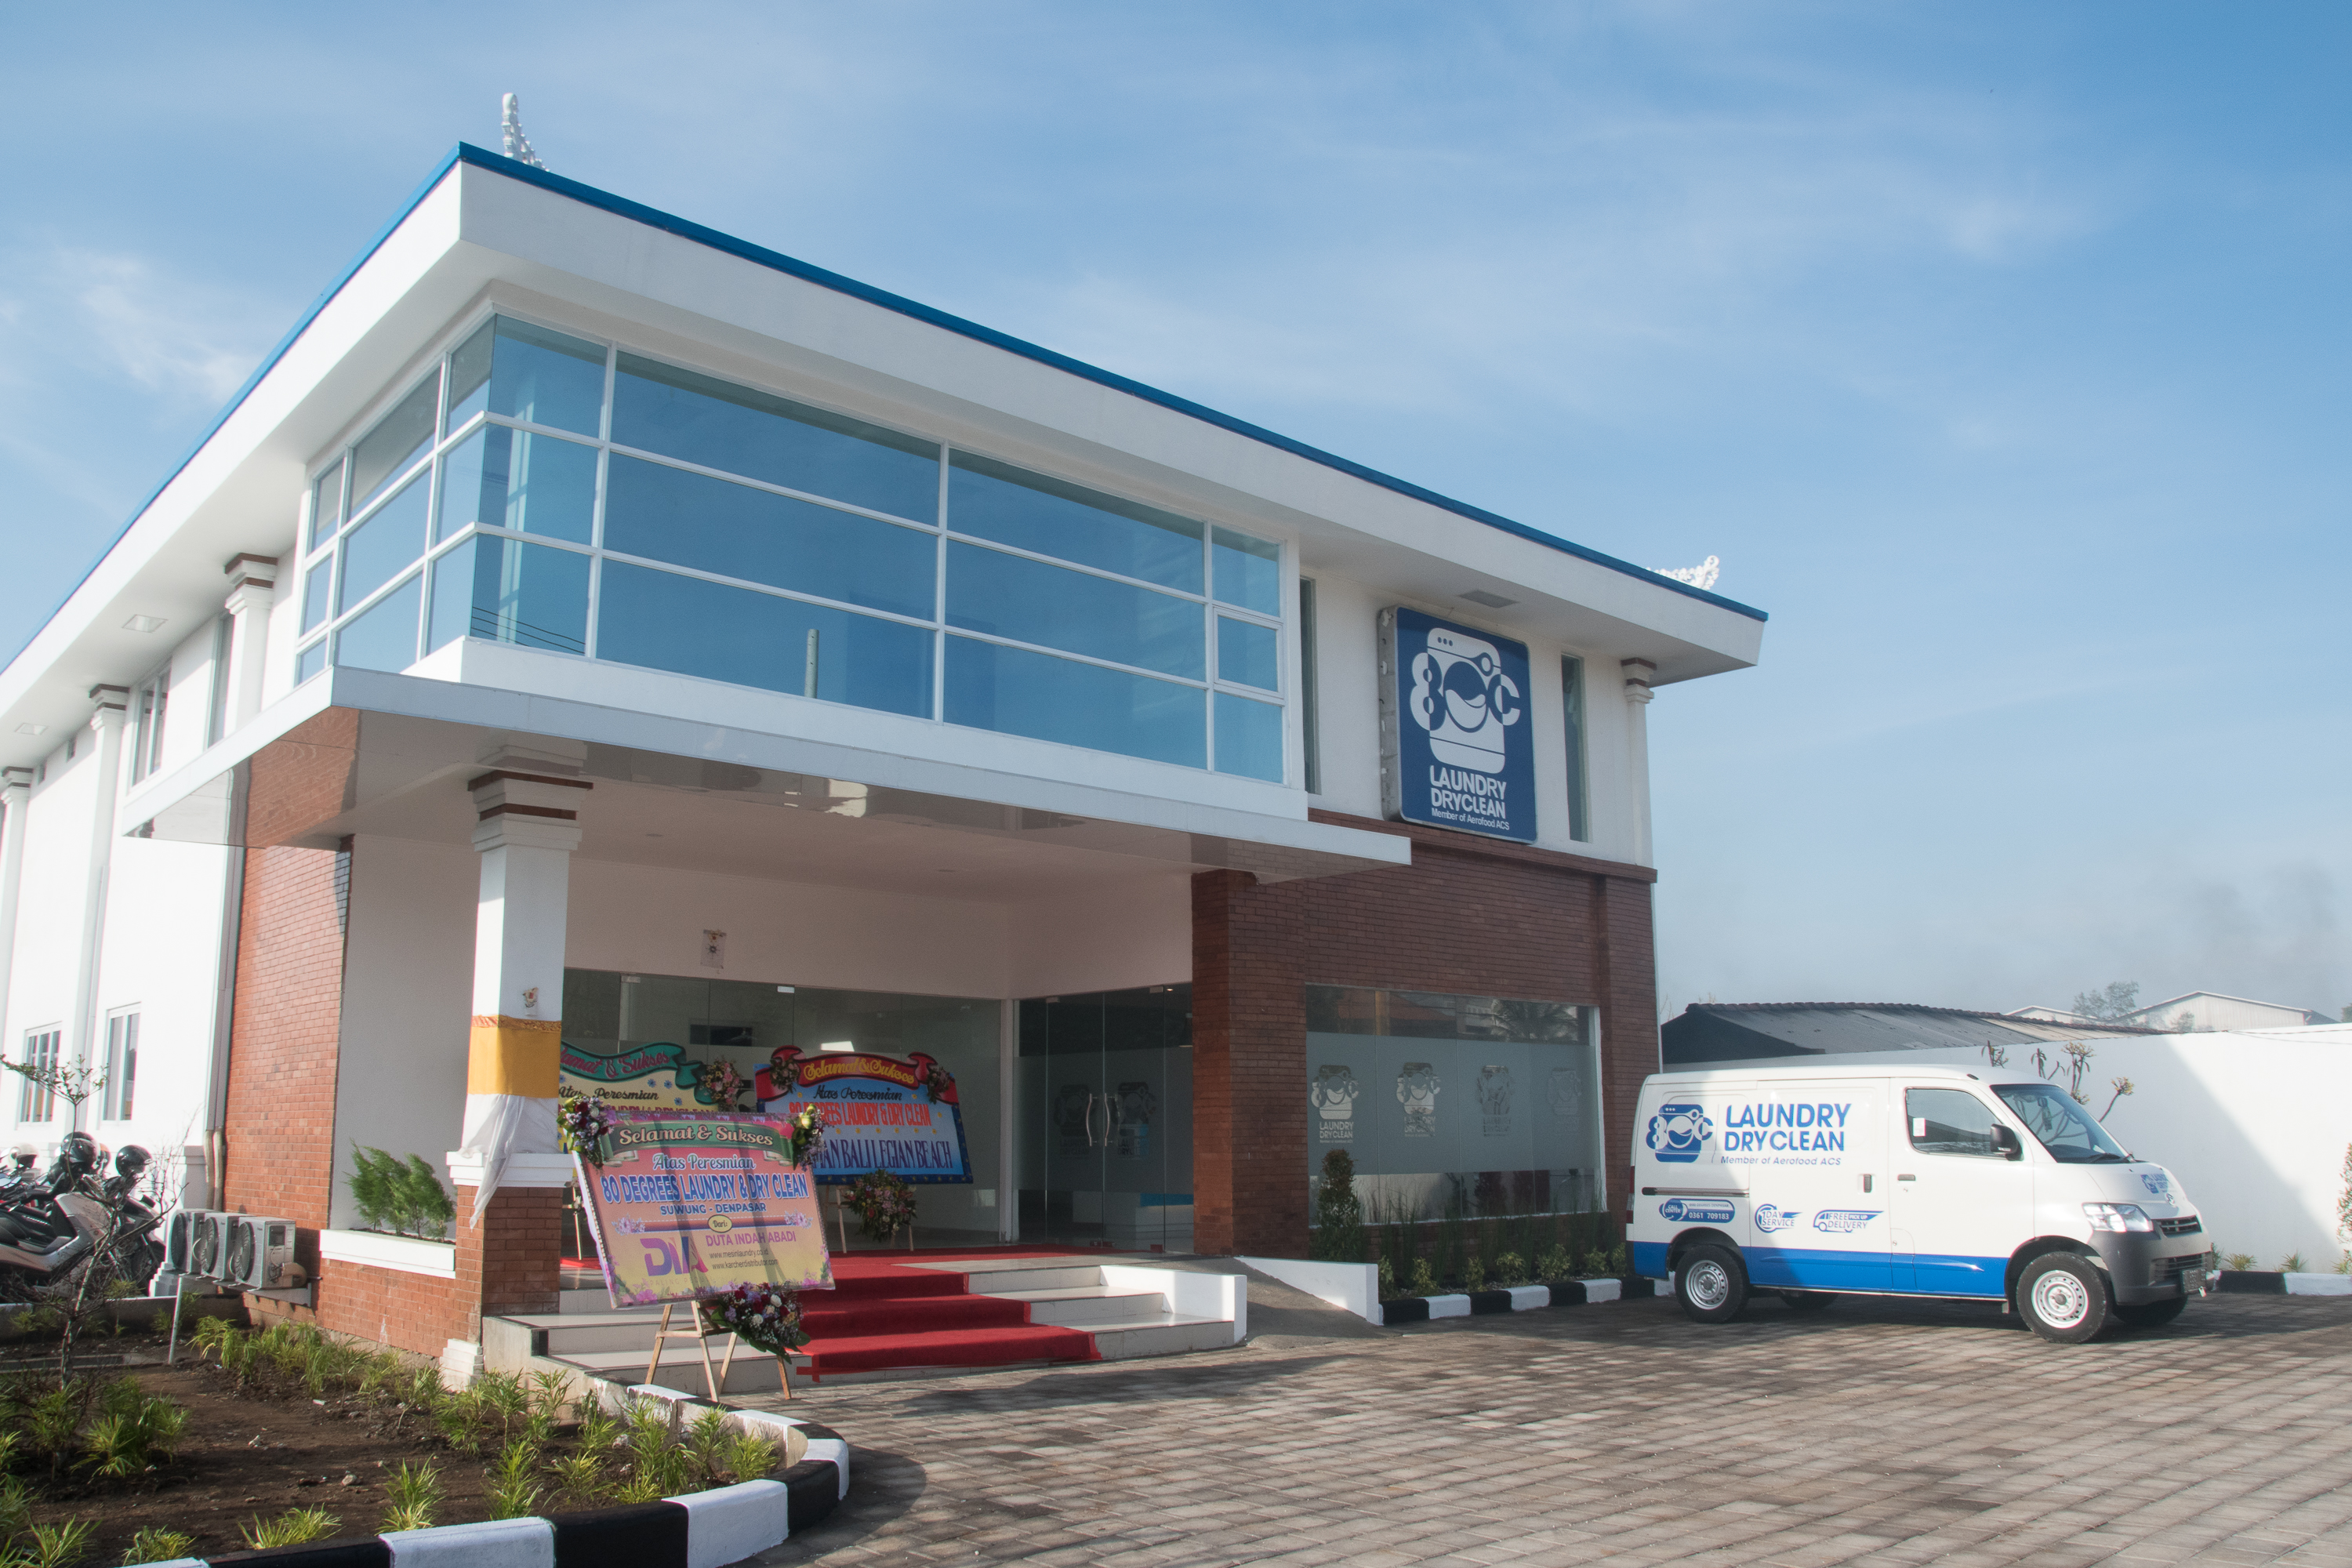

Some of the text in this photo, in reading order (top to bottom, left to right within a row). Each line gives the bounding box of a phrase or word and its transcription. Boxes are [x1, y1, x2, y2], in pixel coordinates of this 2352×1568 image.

[1430, 765, 1507, 800] LAUNDRY
[1431, 788, 1506, 819] DRYCLEAN
[1432, 808, 1510, 831] Member of Aerofood ACS
[561, 1047, 603, 1074] lamat
[618, 1050, 670, 1075] Sukses
[804, 1057, 858, 1080] Selamat
[593, 1087, 659, 1101] Peresmian
[814, 1085, 903, 1102] Atas Peresmian
[841, 1102, 880, 1126] LAUNDRY
[880, 1102, 888, 1126] &
[887, 1102, 905, 1127] DRY
[905, 1102, 932, 1127] CLEAN
[1726, 1103, 1852, 1128] LAUNDRY
[619, 1125, 773, 1146] Selamat & Sukses
[1319, 1122, 1354, 1131] LAUNDRY
[653, 1153, 756, 1170] Atas Peresmian
[840, 1139, 871, 1169] BALI
[871, 1139, 916, 1169] LEGIAN
[916, 1139, 953, 1169] BEACH
[1773, 1156, 1817, 1165] Aerofood
[1820, 1157, 1841, 1166] ACS
[601, 1173, 809, 1203] 80 DEGREES LAUNDRY & DRY CLEAN
[660, 1204, 706, 1215] SUWUNG
[714, 1202, 767, 1214] DENPASAR
[713, 1220, 728, 1229] Dari:
[1828, 1221, 1868, 1229] DELIVERY
[706, 1231, 797, 1247] DUTA INDAH ABADI
